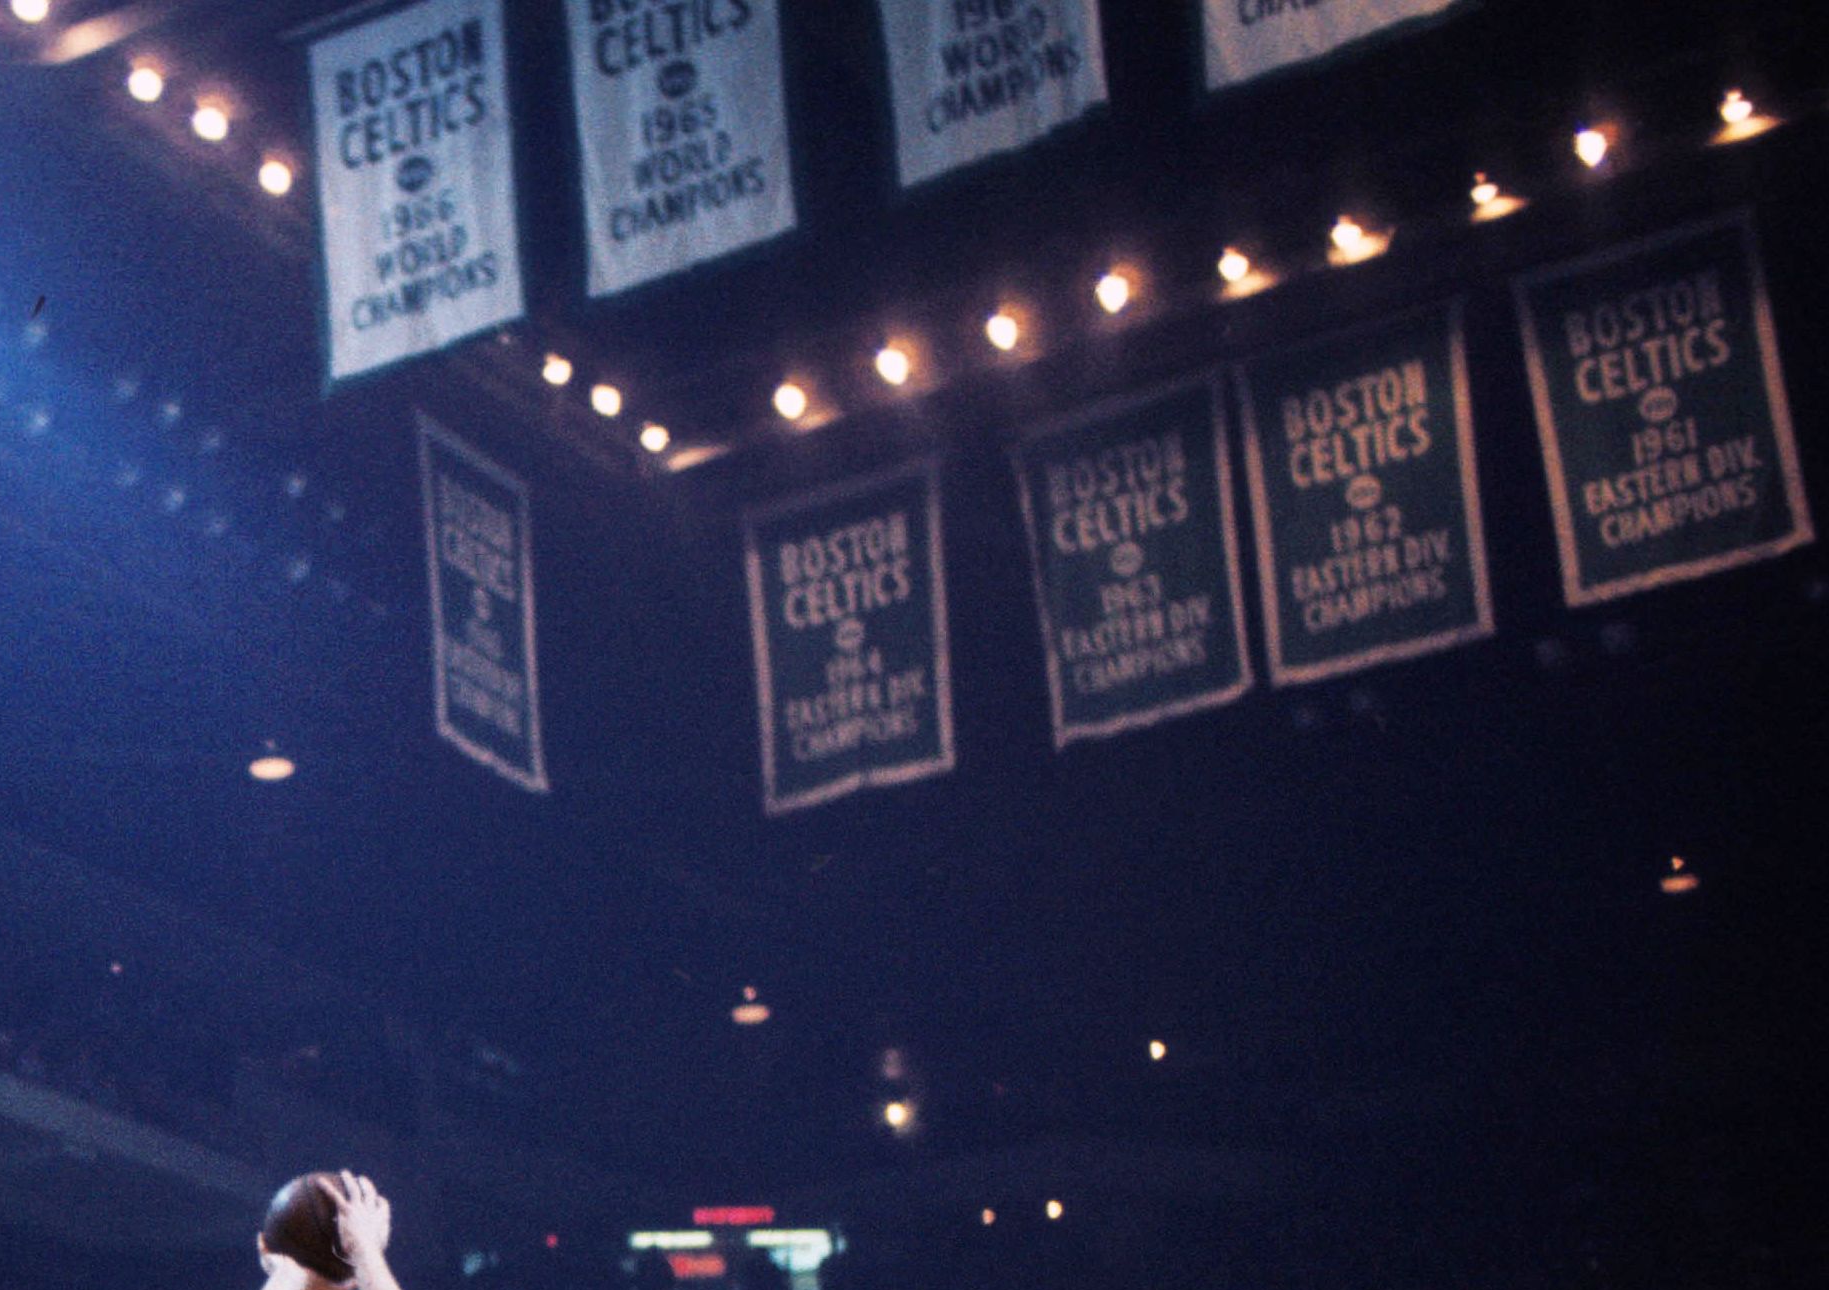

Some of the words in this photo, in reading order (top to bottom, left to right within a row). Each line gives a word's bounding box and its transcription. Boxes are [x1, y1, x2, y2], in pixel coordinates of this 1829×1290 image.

[335, 18, 483, 117] BOSTON
[596, 0, 753, 76] CELTICS
[340, 72, 485, 170] CELTICS
[1564, 269, 1723, 356] BOSTON
[1575, 318, 1731, 403] CELTICS
[1283, 360, 1427, 441] BOSTON
[1046, 432, 1187, 508] BOSTON
[1290, 407, 1432, 488] CELTICS
[1631, 416, 1698, 465] 1961
[1053, 478, 1188, 553] CELTICS
[1583, 452, 1702, 515] EASTERN
[1600, 474, 1758, 548] CHAMPIONS
[779, 512, 908, 585] BOSTON
[784, 557, 911, 630] CELTICS
